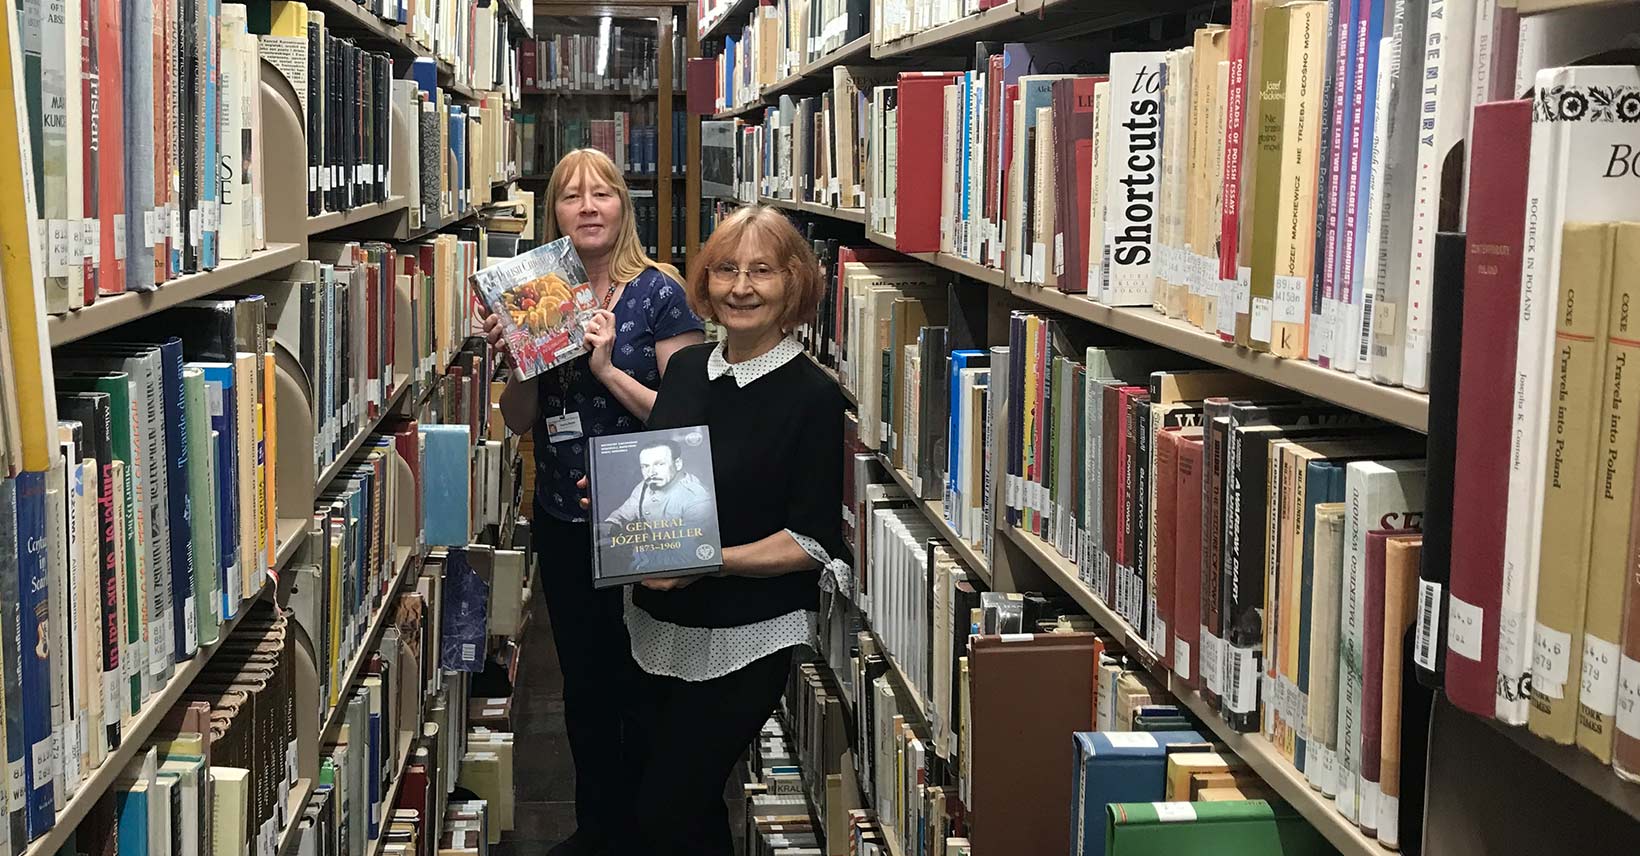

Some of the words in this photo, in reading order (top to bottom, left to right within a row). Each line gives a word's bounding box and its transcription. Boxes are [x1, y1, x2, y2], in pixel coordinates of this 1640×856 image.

[1340, 23, 1349, 58] POLISH
[1358, 20, 1368, 55] POLISH
[1338, 59, 1346, 94] POETRY
[1357, 56, 1365, 91] POETRY
[1478, 35, 1488, 84] BREAD
[1233, 88, 1241, 128] DECADES
[1322, 76, 1332, 134] Through
[1337, 95, 1344, 109] OF
[1355, 93, 1362, 105] OF
[1421, 32, 1441, 147] CENTURY
[90, 66, 99, 151] Tristan
[1335, 110, 1343, 125] THE
[1353, 107, 1361, 124] THE
[1233, 132, 1239, 144] OF
[1319, 139, 1328, 162] the
[1334, 127, 1342, 150] LAST
[1352, 126, 1360, 149] LAST
[1230, 148, 1238, 180] POLISH
[1292, 175, 1301, 240] MACKIEWICZ
[1297, 101, 1306, 142] TRZEBA
[1332, 153, 1340, 172] TWO
[1351, 152, 1359, 171] TWO
[1115, 100, 1158, 266] Shortcuts
[1228, 183, 1236, 216] ESSAYS
[1330, 174, 1339, 211] DECADES
[1348, 174, 1357, 212] DECADES
[1316, 214, 1325, 239] Eye
[1329, 213, 1336, 226] OF
[1347, 214, 1354, 227] OF
[1526, 197, 1539, 253] BOCHECK
[1326, 229, 1336, 285] COMMUNIST
[1344, 230, 1354, 285] COMMUNIST
[1527, 257, 1536, 270] IN
[1523, 273, 1534, 321] POLAND
[1565, 289, 1575, 327] COXE
[1620, 293, 1630, 333] COXE
[1558, 346, 1571, 401] Travels
[1612, 352, 1626, 410] Travels
[1556, 406, 1567, 434] into
[1609, 414, 1621, 444] into
[1553, 439, 1565, 489] Poland
[1605, 449, 1618, 500] Poland
[1233, 477, 1242, 490] A
[98, 463, 116, 543] Emperor
[1351, 487, 1360, 552] WSCHODU
[126, 503, 134, 541] Dybek
[610, 533, 649, 548] JÓZEF
[652, 527, 703, 541] HALLER
[1231, 491, 1241, 556] WARSAW
[104, 552, 117, 571] of
[106, 577, 118, 607] the
[1231, 558, 1241, 605] DIARY
[1349, 555, 1357, 628] DALEKIEGO
[107, 612, 119, 669] Earth
[1344, 705, 1353, 771] ENTENCJE
